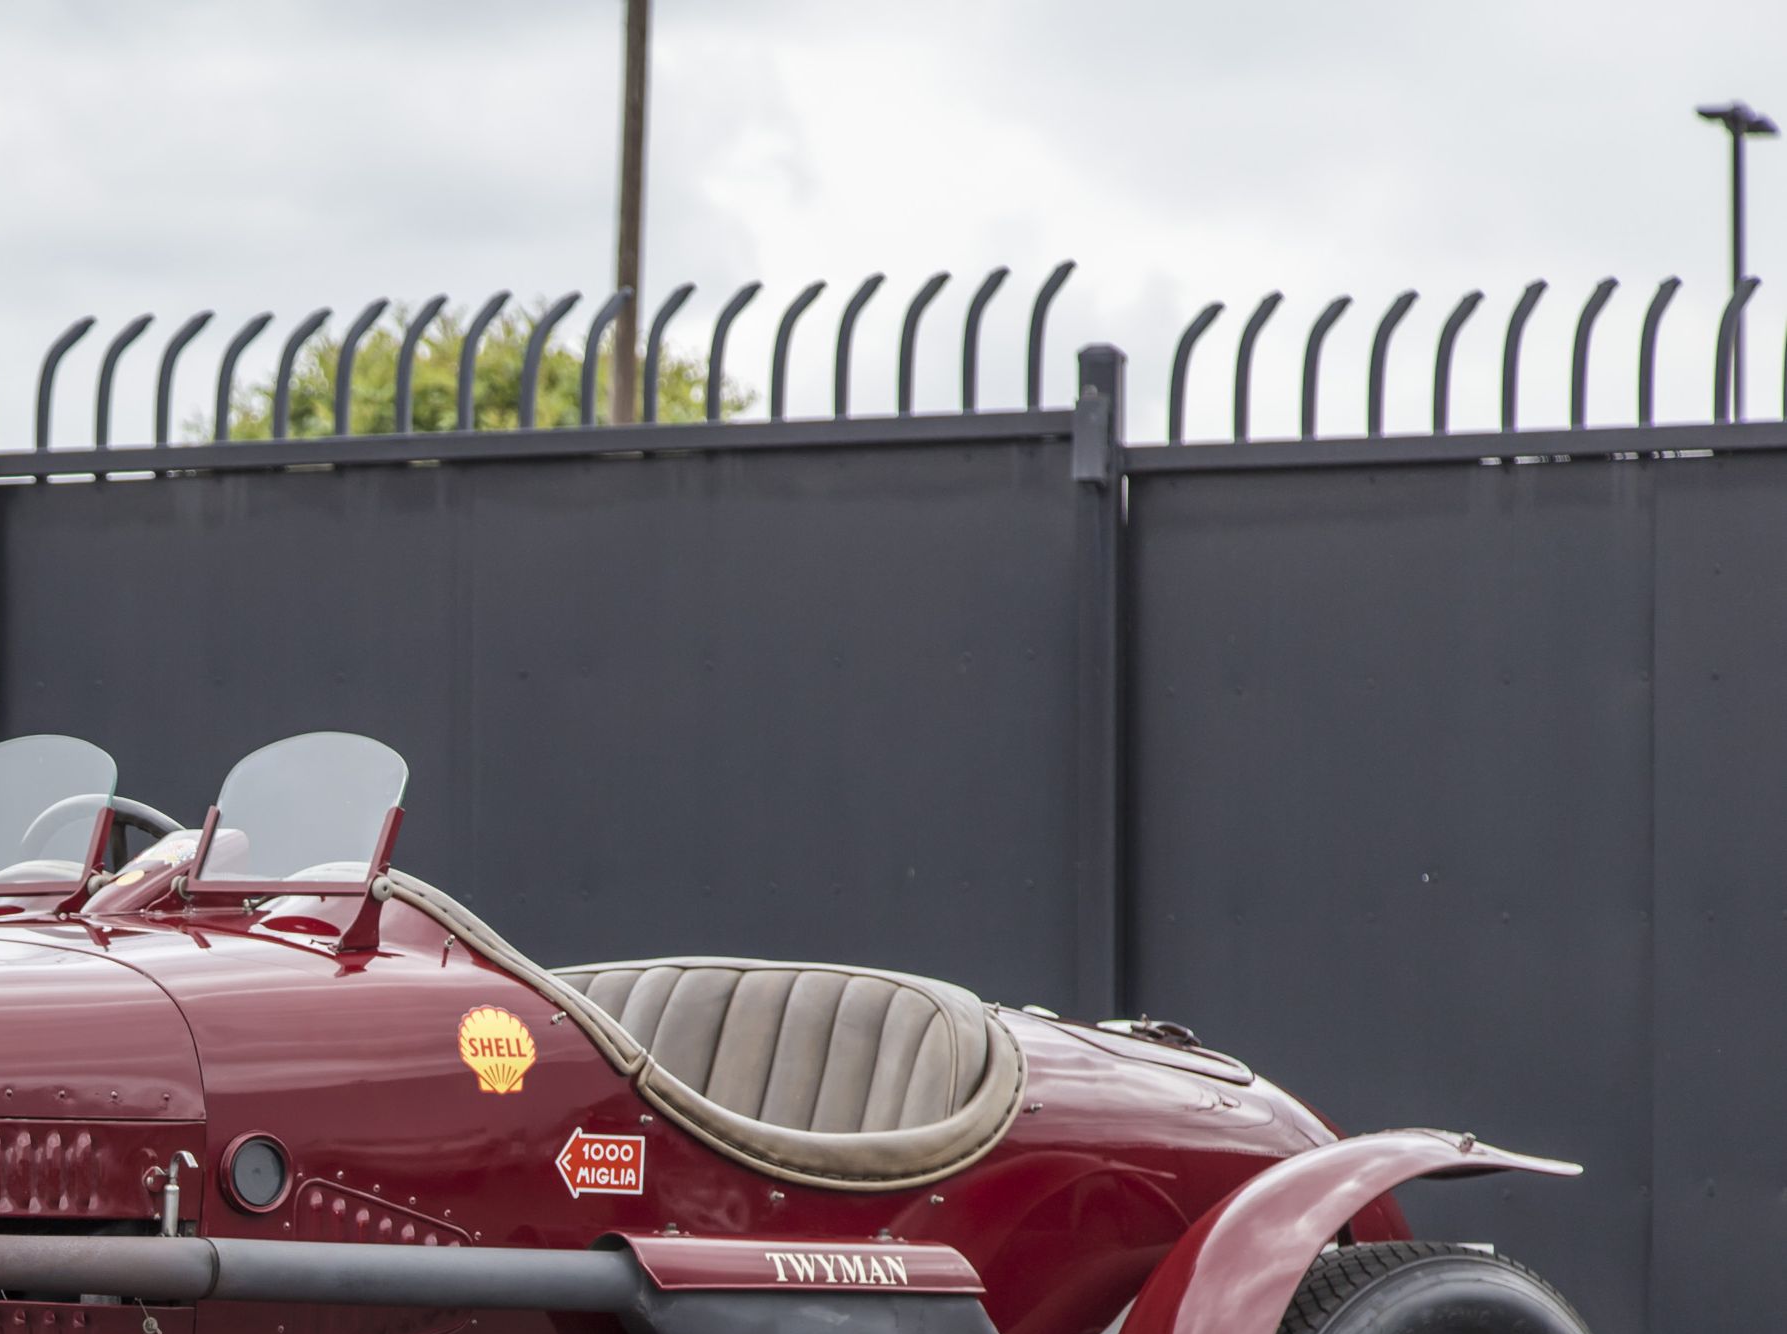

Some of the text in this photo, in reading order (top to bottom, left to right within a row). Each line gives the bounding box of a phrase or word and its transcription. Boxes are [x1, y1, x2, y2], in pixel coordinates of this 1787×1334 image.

[468, 1037, 528, 1058] SHELL
[582, 1143, 634, 1162] 1000
[576, 1167, 636, 1186] MIGLIA
[765, 1252, 908, 1286] TWYMAN
